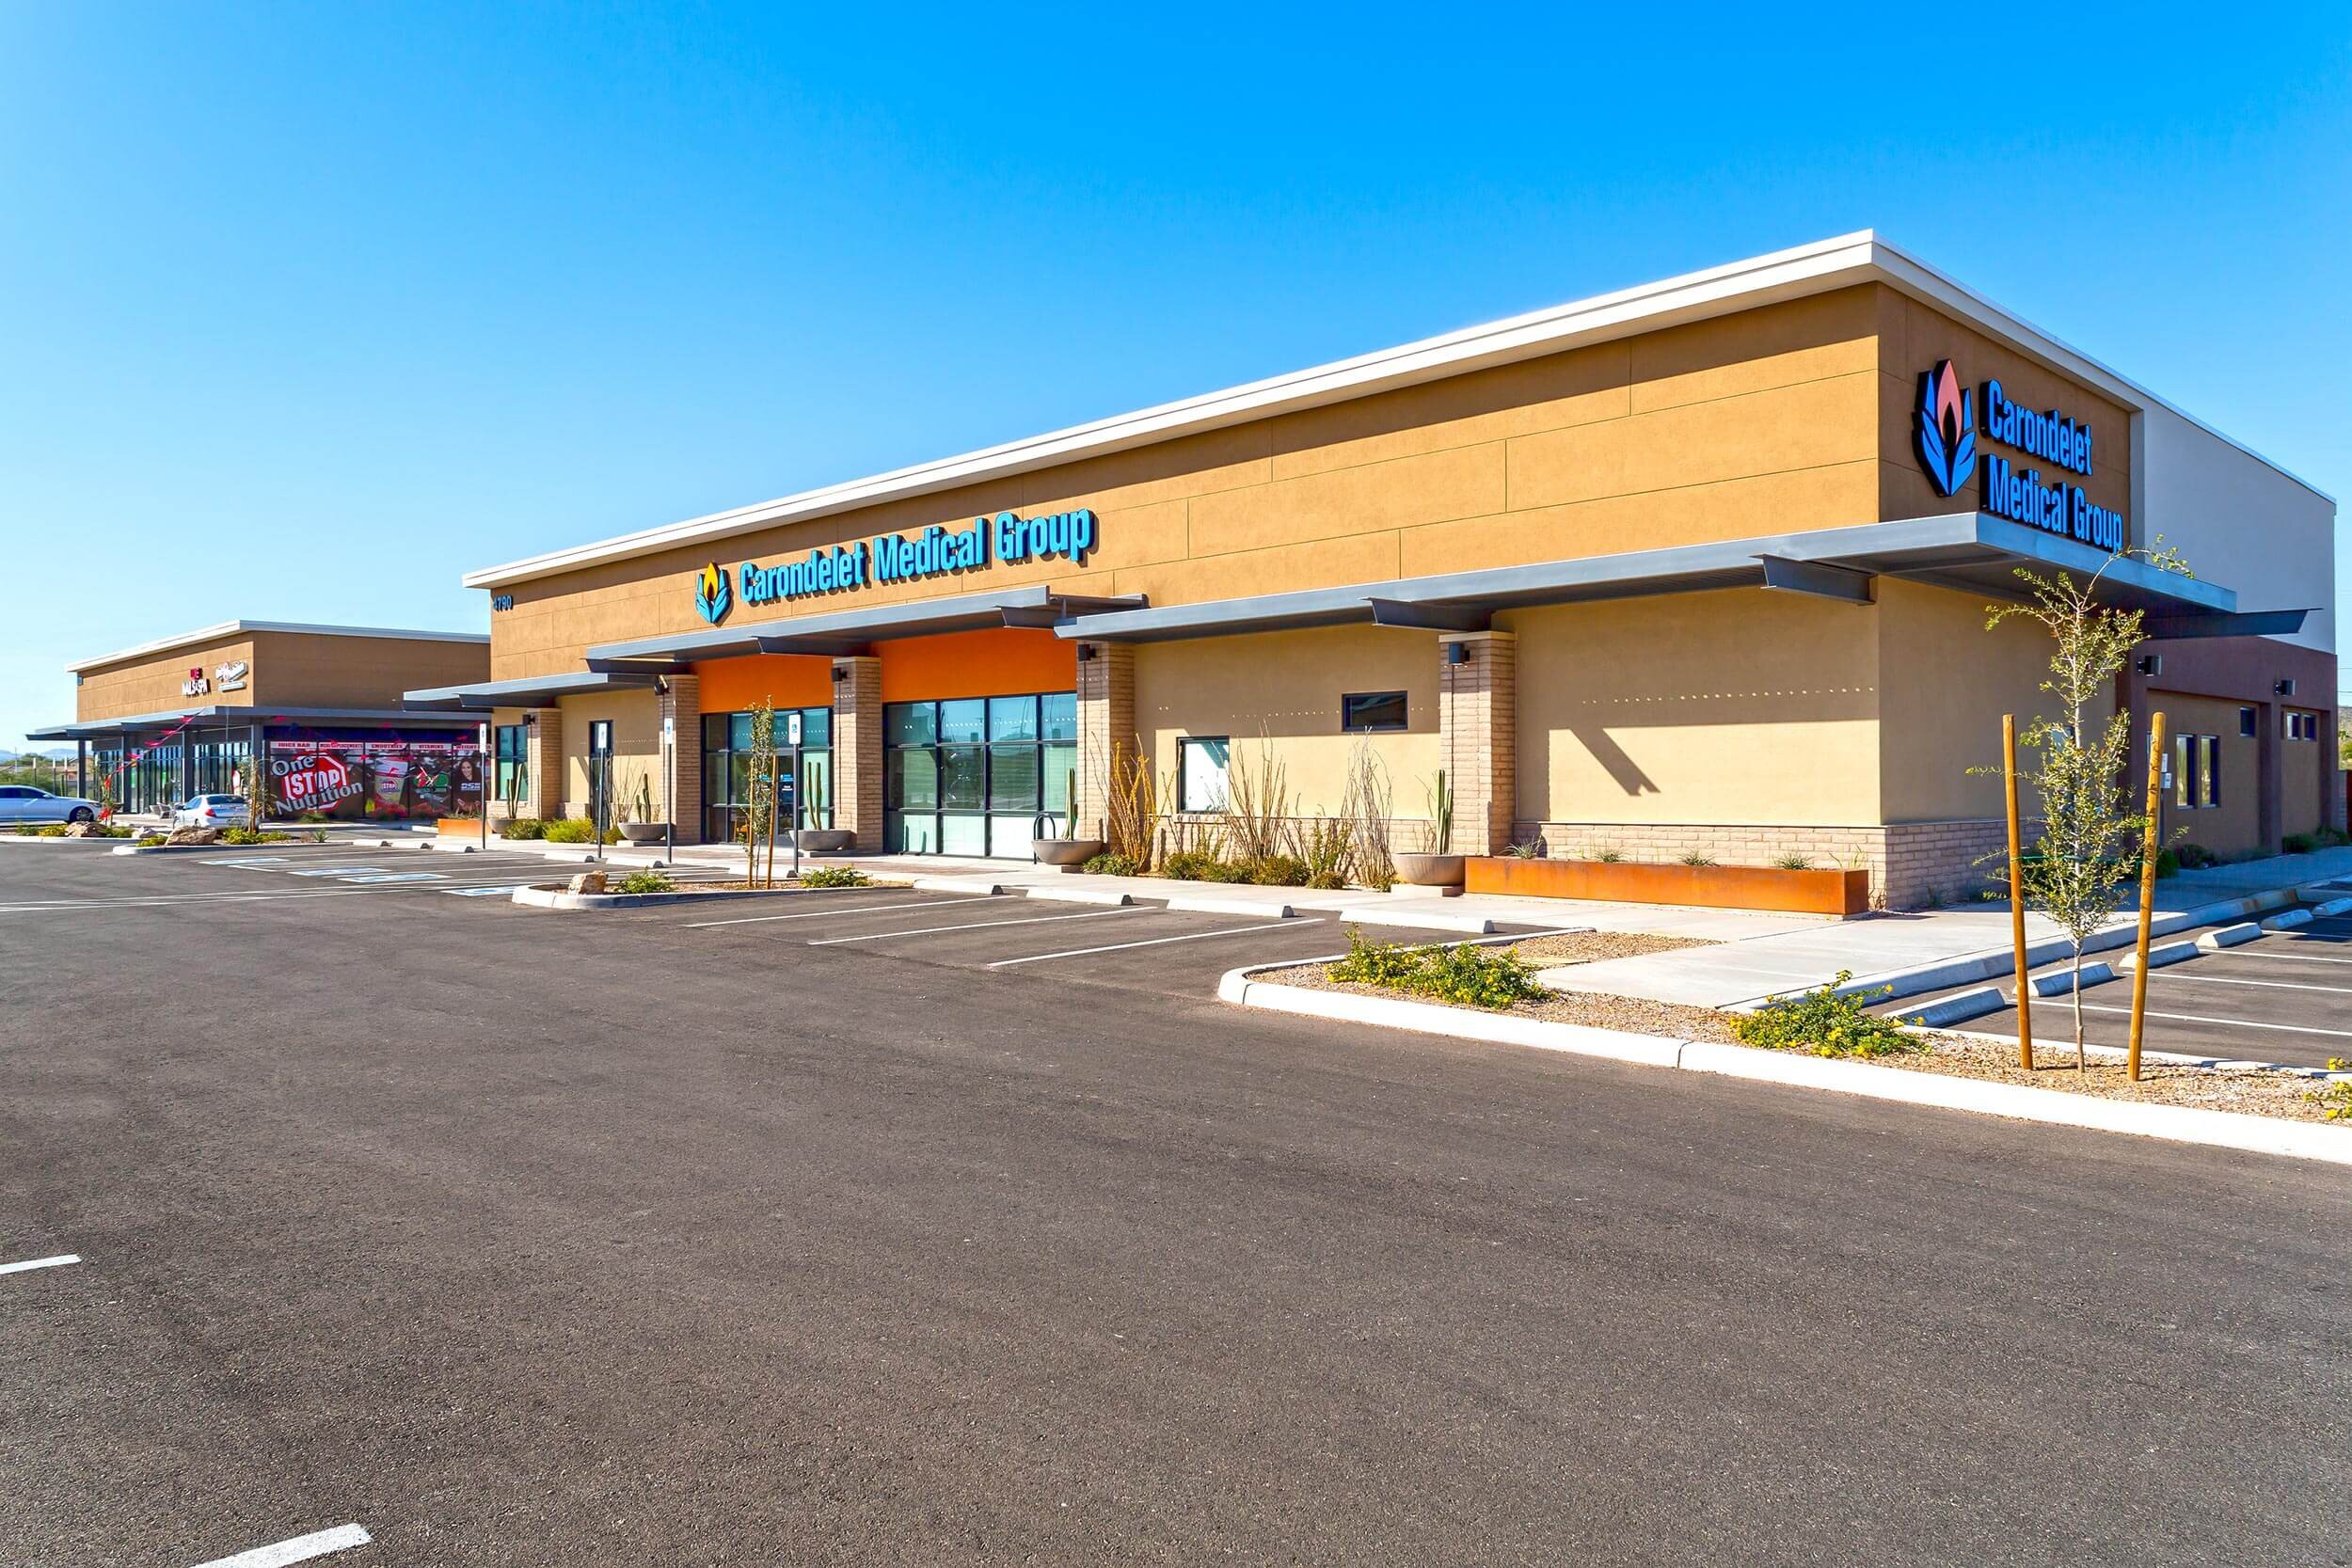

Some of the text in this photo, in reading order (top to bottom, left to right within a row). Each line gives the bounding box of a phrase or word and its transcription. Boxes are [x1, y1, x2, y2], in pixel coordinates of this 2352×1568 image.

[1988, 379, 2092, 476] Carondelet
[1988, 454, 2123, 554] Medical Group
[739, 509, 1093, 603] Carondelet Medical Group
[272, 755, 315, 776] One
[291, 768, 341, 795] STOP
[275, 782, 363, 816] Nutrition
